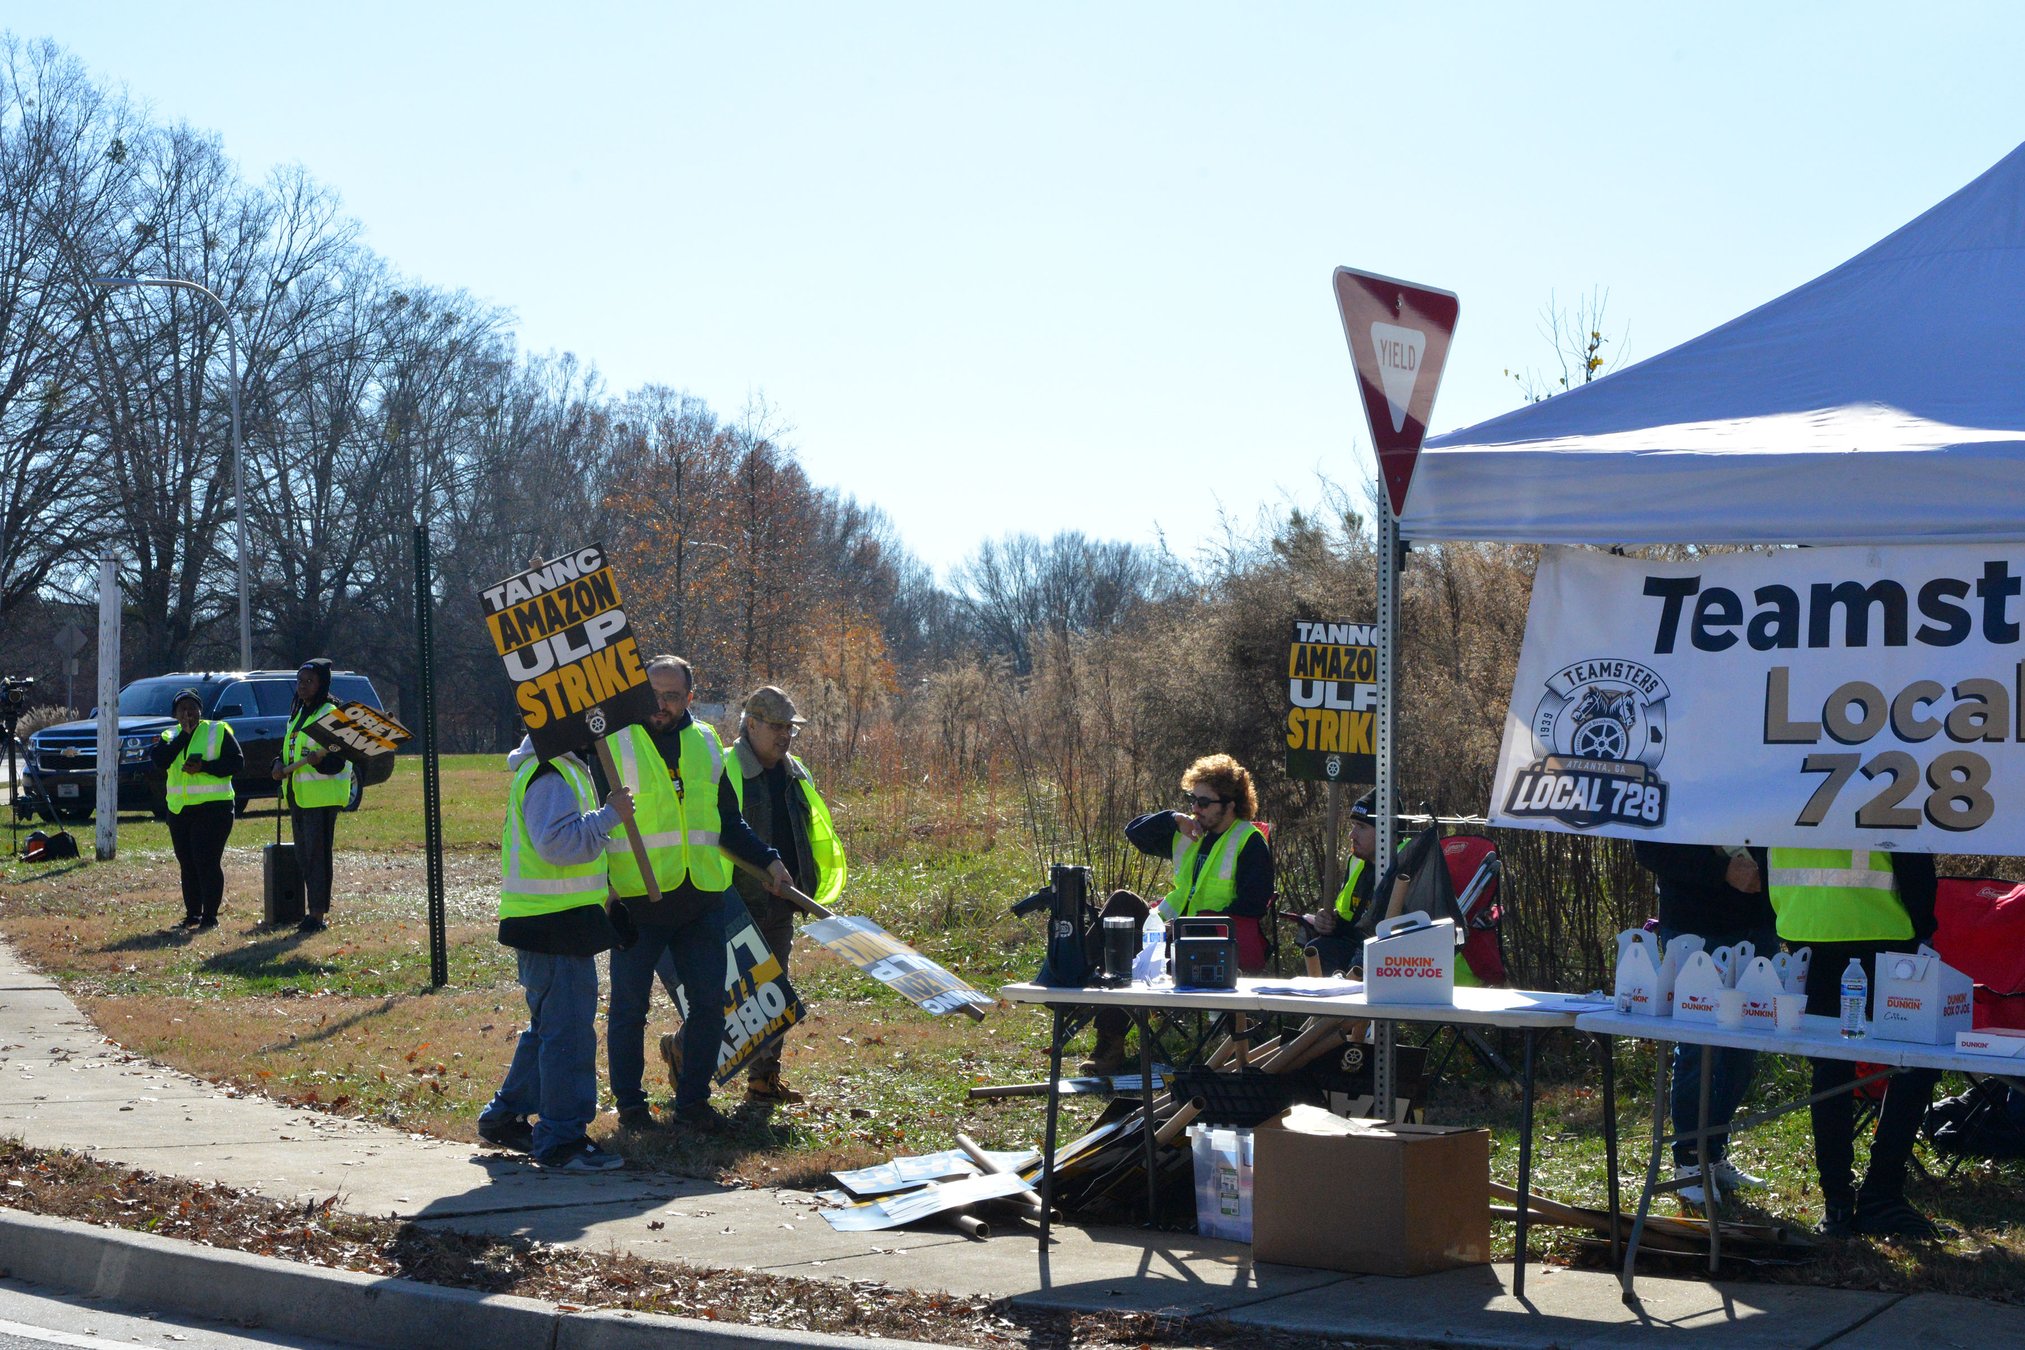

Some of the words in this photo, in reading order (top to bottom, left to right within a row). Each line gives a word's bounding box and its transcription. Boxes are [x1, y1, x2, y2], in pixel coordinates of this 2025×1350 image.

[1380, 339, 1416, 371] YIELD
[482, 547, 602, 612] TANNC
[497, 569, 617, 652] AMAZON
[502, 609, 627, 682] ULP
[1296, 622, 1378, 646] TANN
[1294, 646, 1377, 682] AMAZO
[1563, 662, 1660, 694] TEAMSTERS
[515, 636, 648, 730] STRIKE
[317, 713, 394, 757] LAW
[344, 706, 405, 737] OBEY
[1286, 706, 1377, 755] STRIK
[1540, 712, 1553, 738] 1939
[1614, 765, 1626, 774] GA
[1511, 775, 1605, 811] LOCAL
[1611, 780, 1661, 822] 728
[1794, 750, 1995, 832] 728
[1376, 967, 1401, 977] BOX
[1384, 956, 1435, 967] DUNKIN'
[1682, 1002, 1714, 1011] DUNKIN'
[1887, 999, 1922, 1010] DUNKIN'
